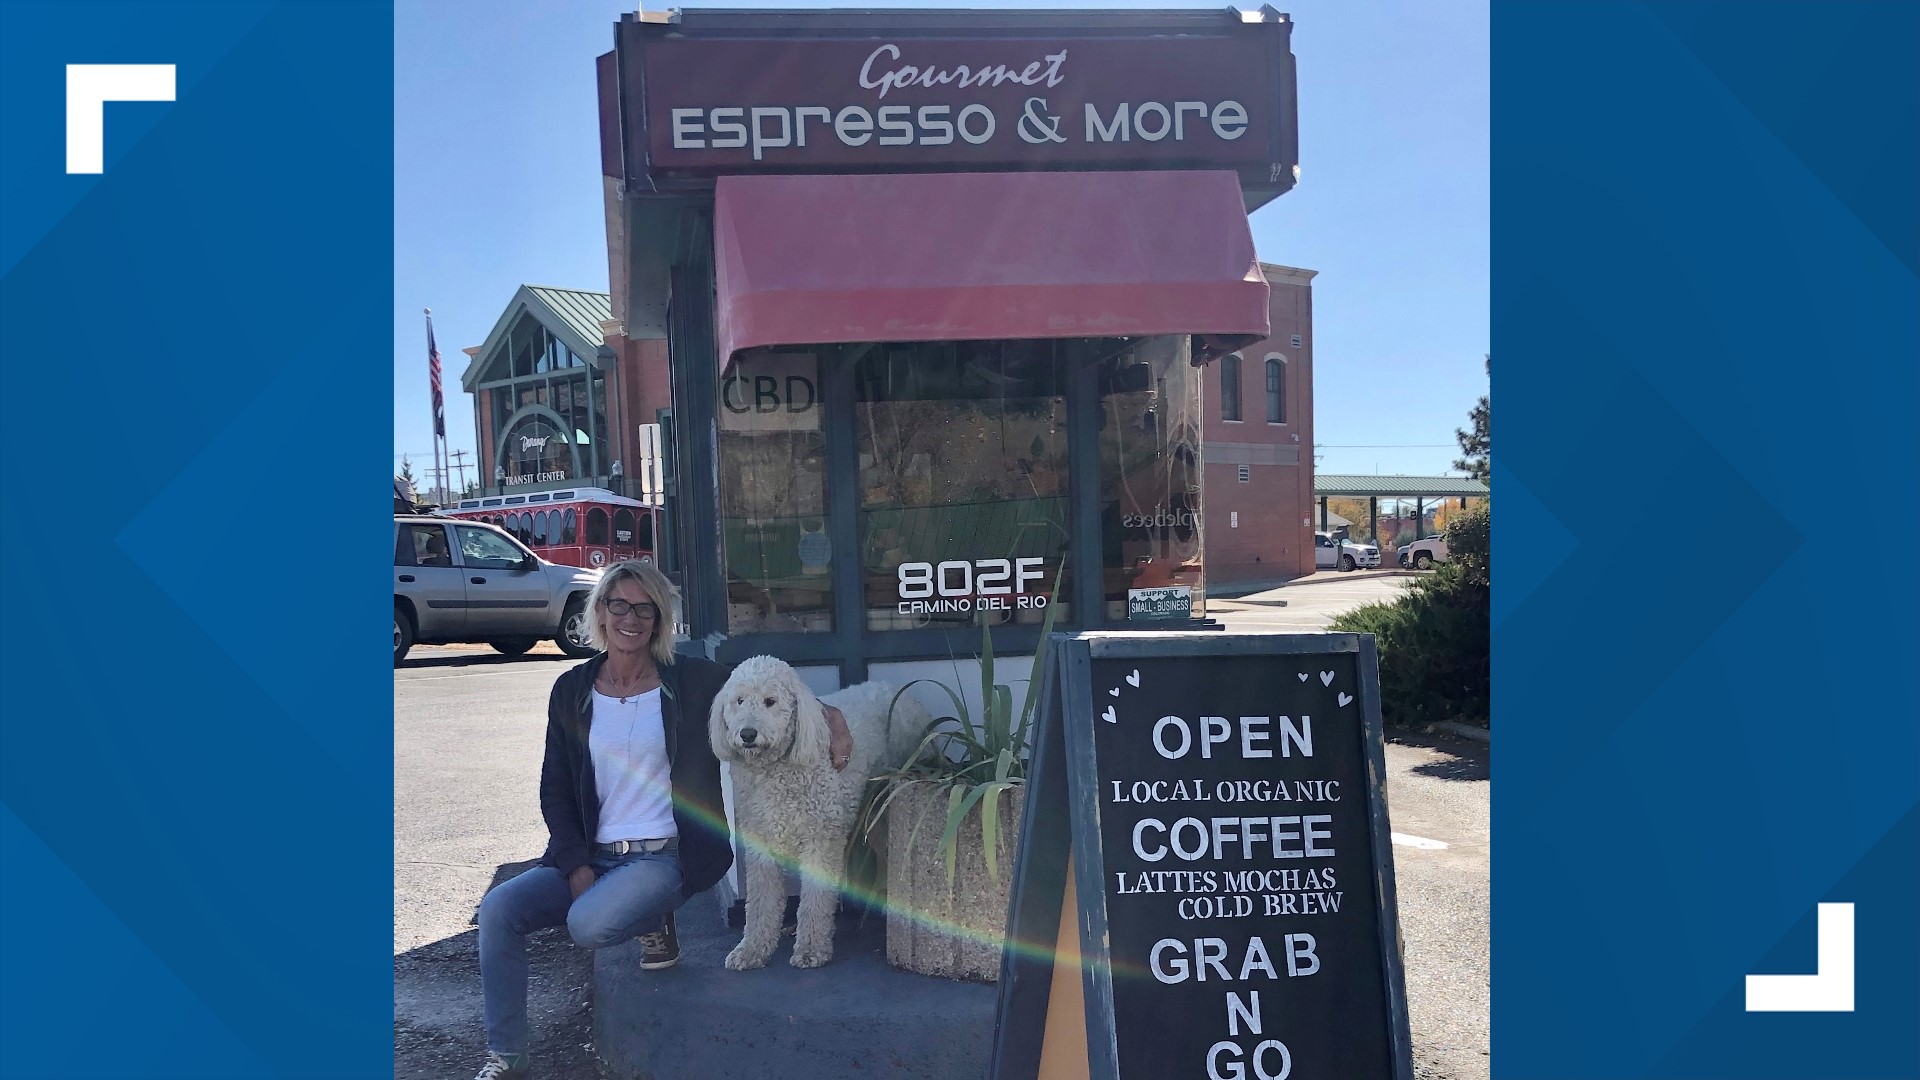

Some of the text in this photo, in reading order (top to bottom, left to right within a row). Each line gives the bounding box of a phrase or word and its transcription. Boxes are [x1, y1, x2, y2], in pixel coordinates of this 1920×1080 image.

[859, 43, 1067, 98] Gourmet
[672, 97, 1249, 160] Espresso & More
[723, 375, 815, 414] CBD
[505, 471, 565, 486] TRANSIT CENTER
[898, 557, 1044, 599] 802F
[1140, 589, 1179, 597] SUPPORT
[898, 595, 1047, 615] CAMINO DEL RIO
[1131, 599, 1189, 613] SMALL BUSINESS
[1152, 715, 1314, 760] OPEN
[1111, 779, 1341, 803] LOCAL ORGANIC
[1132, 814, 1336, 862] COFFEE
[1116, 867, 1337, 895] LATTES MOCHAS
[1178, 891, 1344, 921] COLD BREW
[1150, 932, 1321, 985] GRAB
[1226, 990, 1263, 1037] N
[1206, 1039, 1292, 1080] GO
